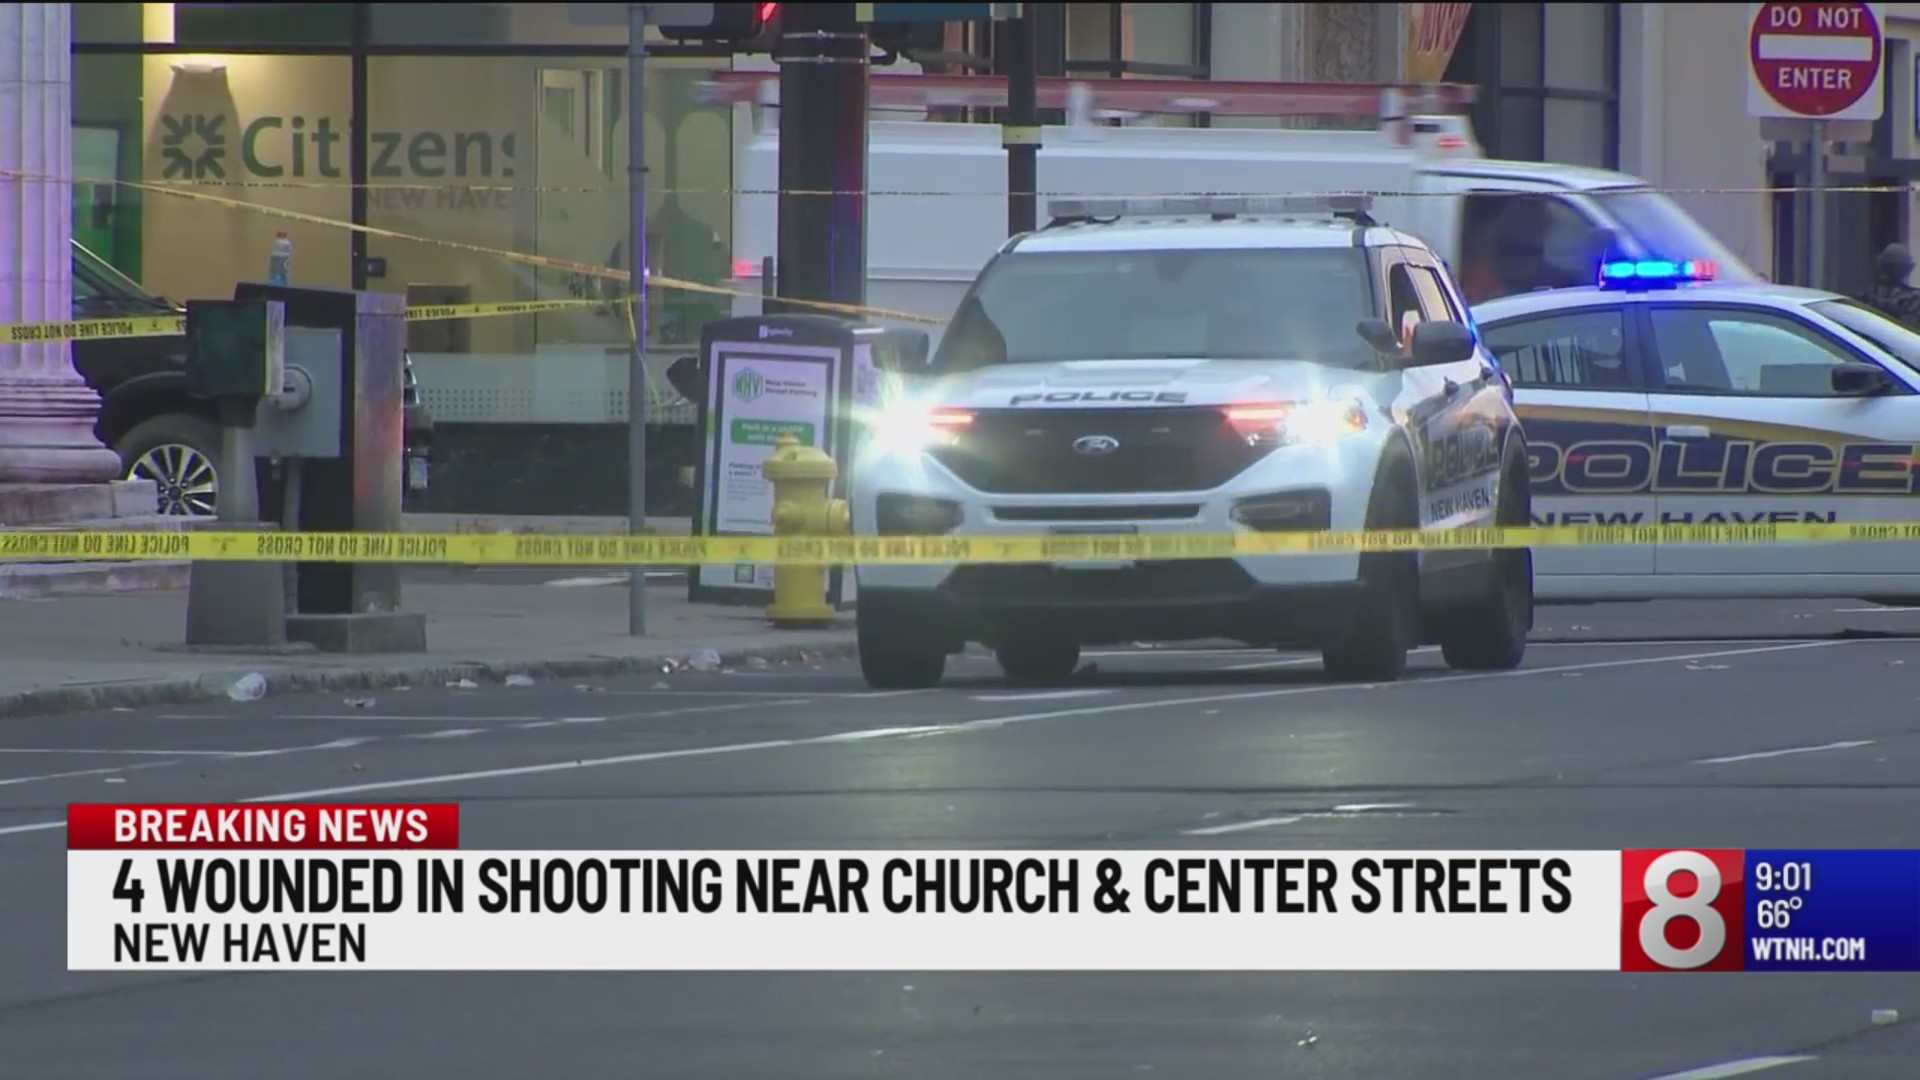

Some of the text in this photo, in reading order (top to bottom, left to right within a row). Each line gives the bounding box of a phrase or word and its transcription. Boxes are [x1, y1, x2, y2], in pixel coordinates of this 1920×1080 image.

[1771, 6, 1862, 29] DO NOT
[1778, 67, 1852, 90] ENTER
[242, 116, 515, 178] Citzen
[11, 321, 134, 341] POLICE LINE DO NOT CROSS
[1010, 391, 1187, 406] POLICE
[1661, 511, 1837, 525] HAVEN
